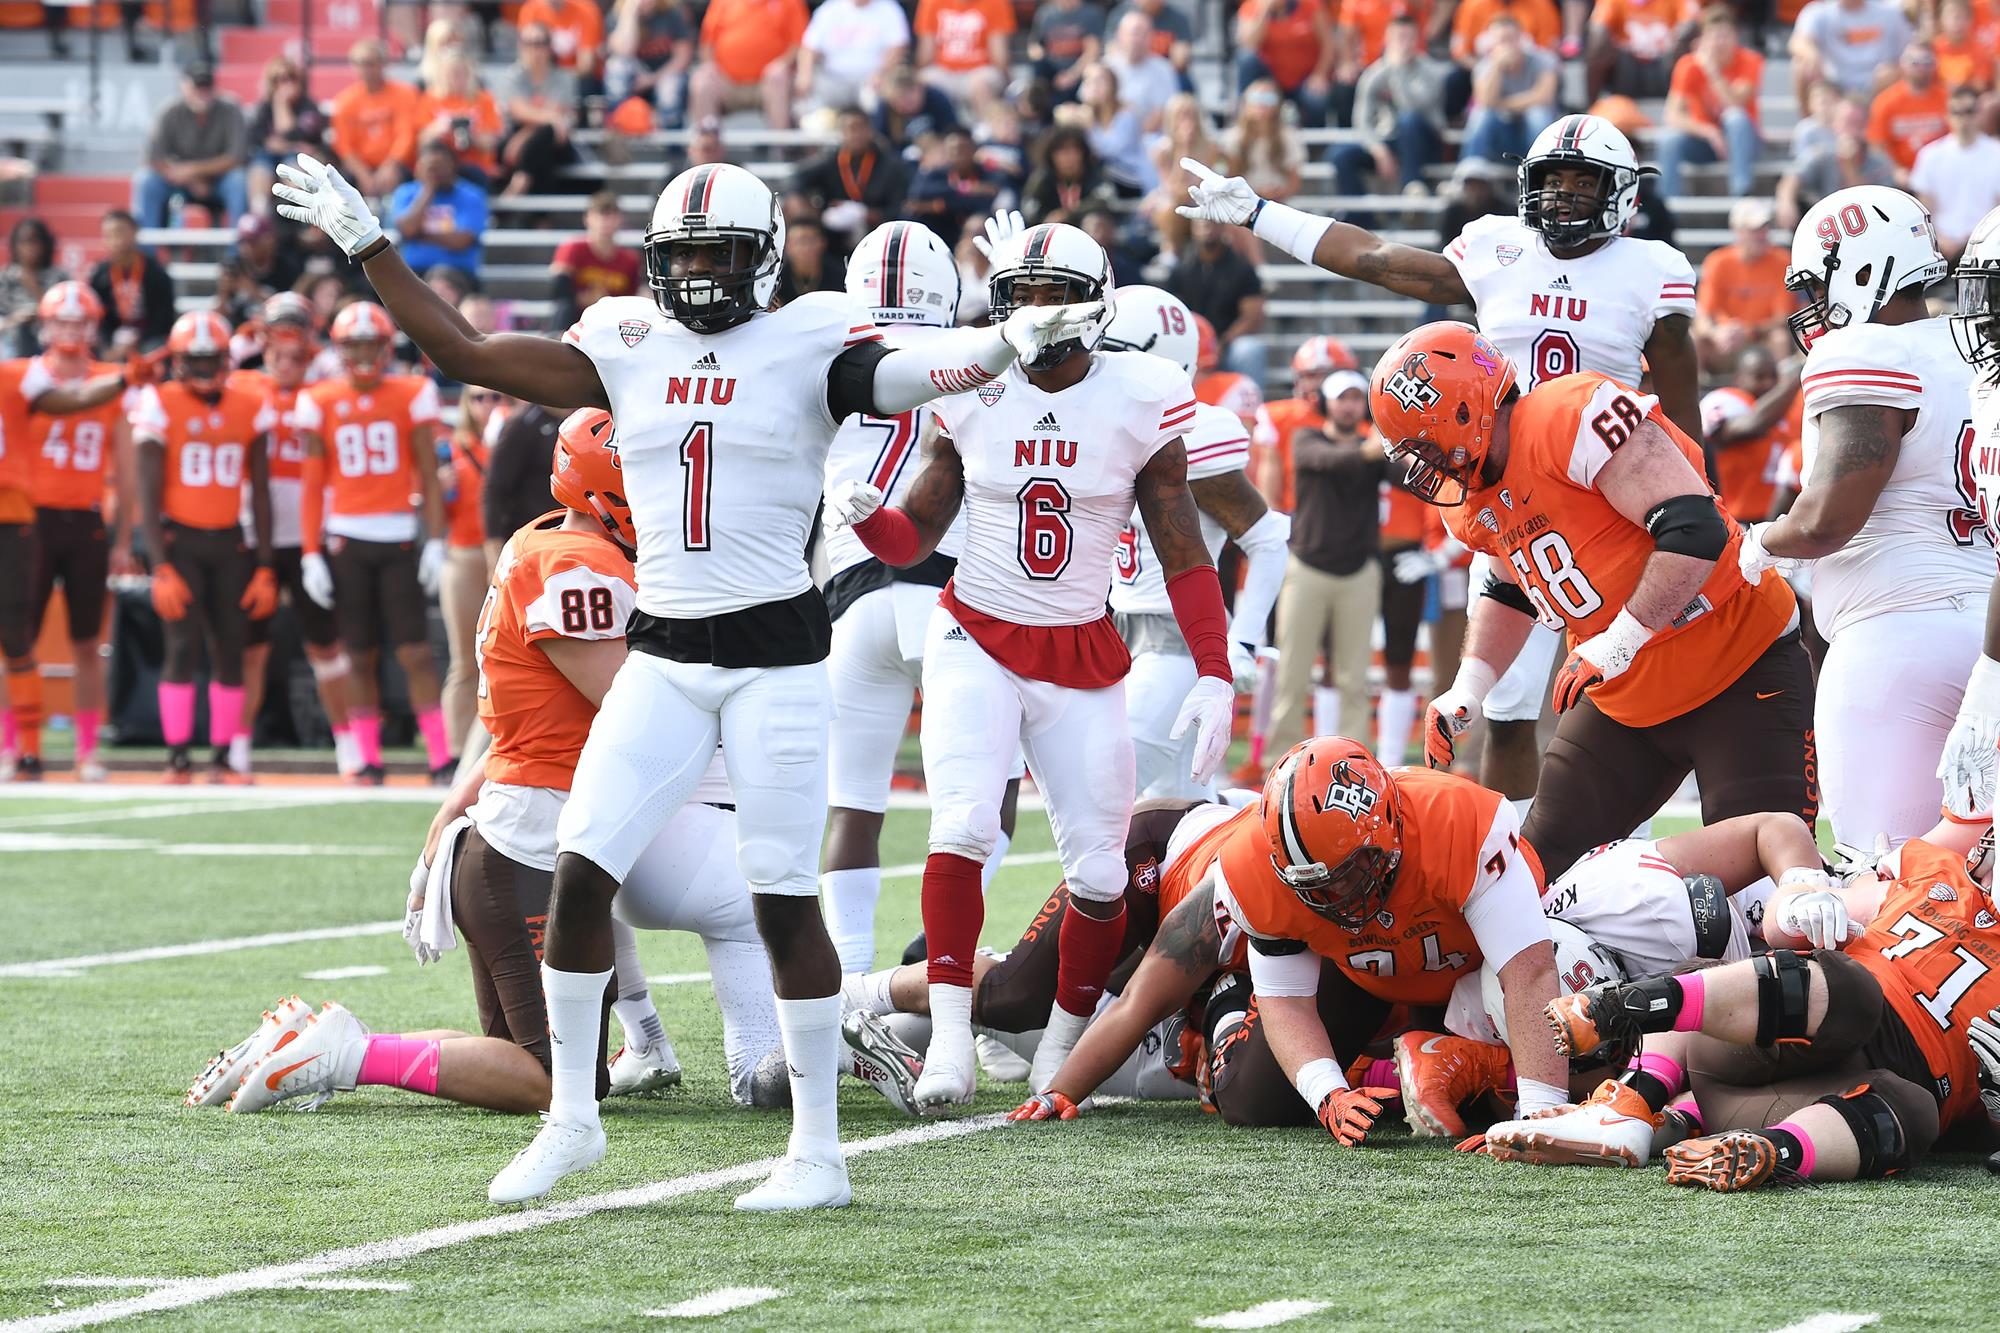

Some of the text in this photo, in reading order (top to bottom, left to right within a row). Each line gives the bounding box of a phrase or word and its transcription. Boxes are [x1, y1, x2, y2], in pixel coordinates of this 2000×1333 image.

[1816, 203, 1868, 251] 90
[1923, 268, 1938, 277] THE
[878, 312, 904, 320] HARD
[907, 312, 926, 320] WAY
[1157, 304, 1187, 336] 19
[1530, 293, 1587, 322] NIU
[691, 362, 721, 371] adidas
[1529, 328, 1580, 393] 8
[665, 377, 737, 405] NIU
[1032, 422, 1061, 432] adidas
[1591, 394, 1643, 454] 68
[335, 421, 398, 477] 89
[1014, 439, 1078, 468] NIU
[1979, 446, 2000, 476] NI
[679, 421, 713, 552] 1
[1016, 476, 1073, 581] 6
[1524, 512, 1551, 535] GREEN
[560, 587, 615, 634] 88
[1683, 602, 1699, 615] 3XL
[1916, 900, 1970, 940] BOWLING
[1348, 933, 1400, 947] BOWLING
[1561, 960, 1594, 994] 5
[1880, 911, 1992, 1033] 71
[851, 1050, 889, 1082] adidas
[1941, 1077, 1951, 1097] 2XL
